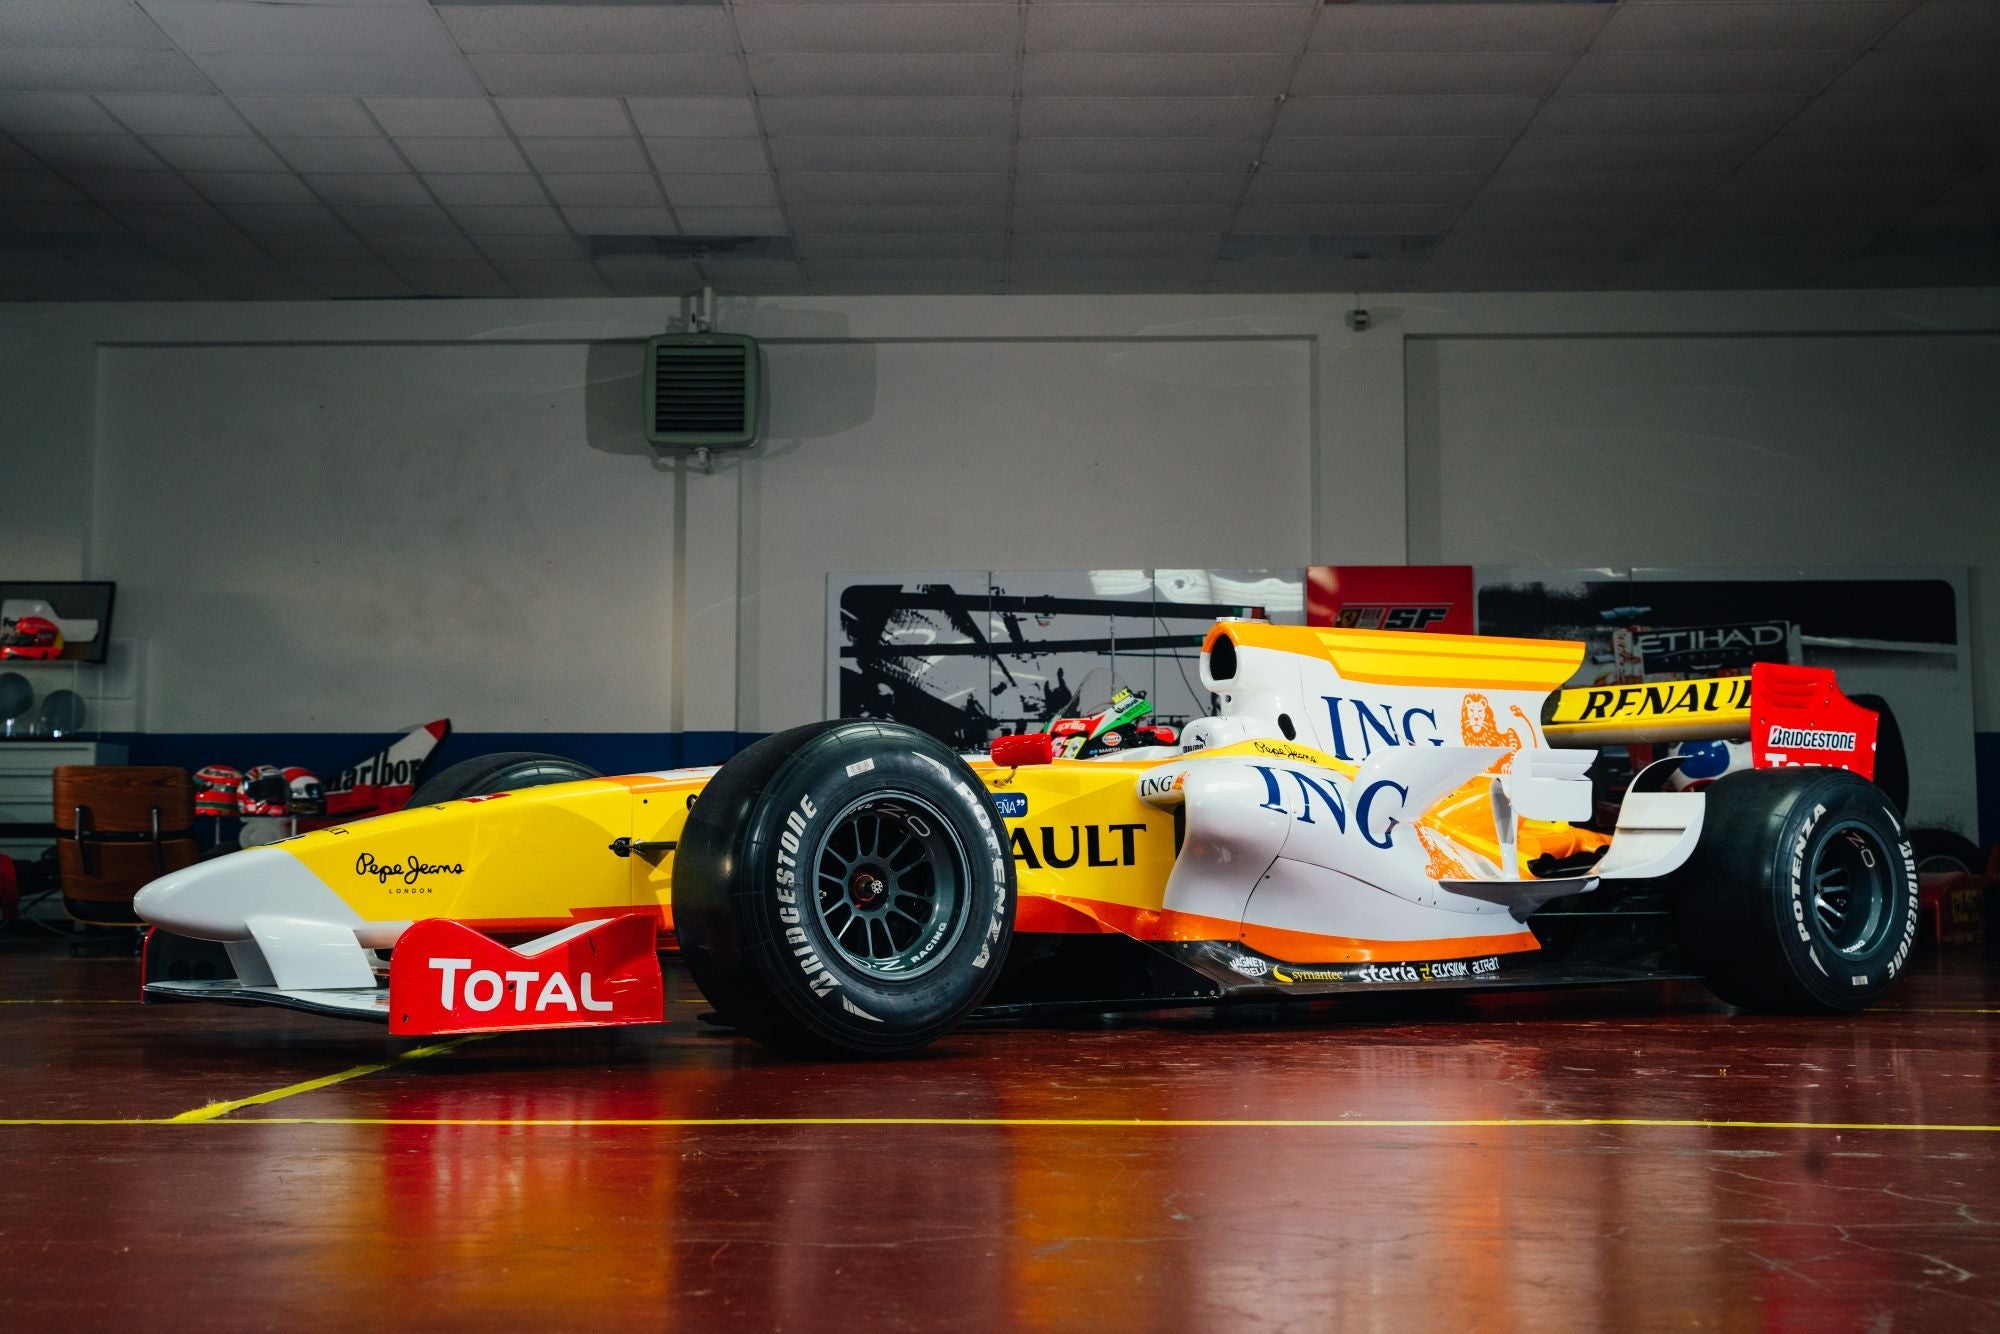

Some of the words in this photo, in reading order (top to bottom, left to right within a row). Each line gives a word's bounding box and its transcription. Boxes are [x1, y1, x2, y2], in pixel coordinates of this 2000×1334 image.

[1634, 625, 1783, 653] ETIHAD
[1056, 719, 1086, 731] aprilia
[1321, 696, 1444, 761] ING
[1770, 728, 1855, 749] BRIDGESTONE
[1141, 775, 1173, 796] ING
[1245, 765, 1409, 850] ING
[356, 853, 404, 884] Pepe
[404, 855, 465, 884] Jeans
[954, 781, 1007, 969] POTENZA
[1791, 803, 1827, 942] POTENZA
[776, 794, 842, 998] BRIDGESTONE
[1887, 840, 1919, 979] BRIDGESTONE
[910, 922, 948, 964] RACING
[428, 958, 613, 1012] TOTAL
[1291, 970, 1344, 982] symantec
[1359, 962, 1420, 982] steria
[1431, 962, 1470, 978] ELYSIUM
